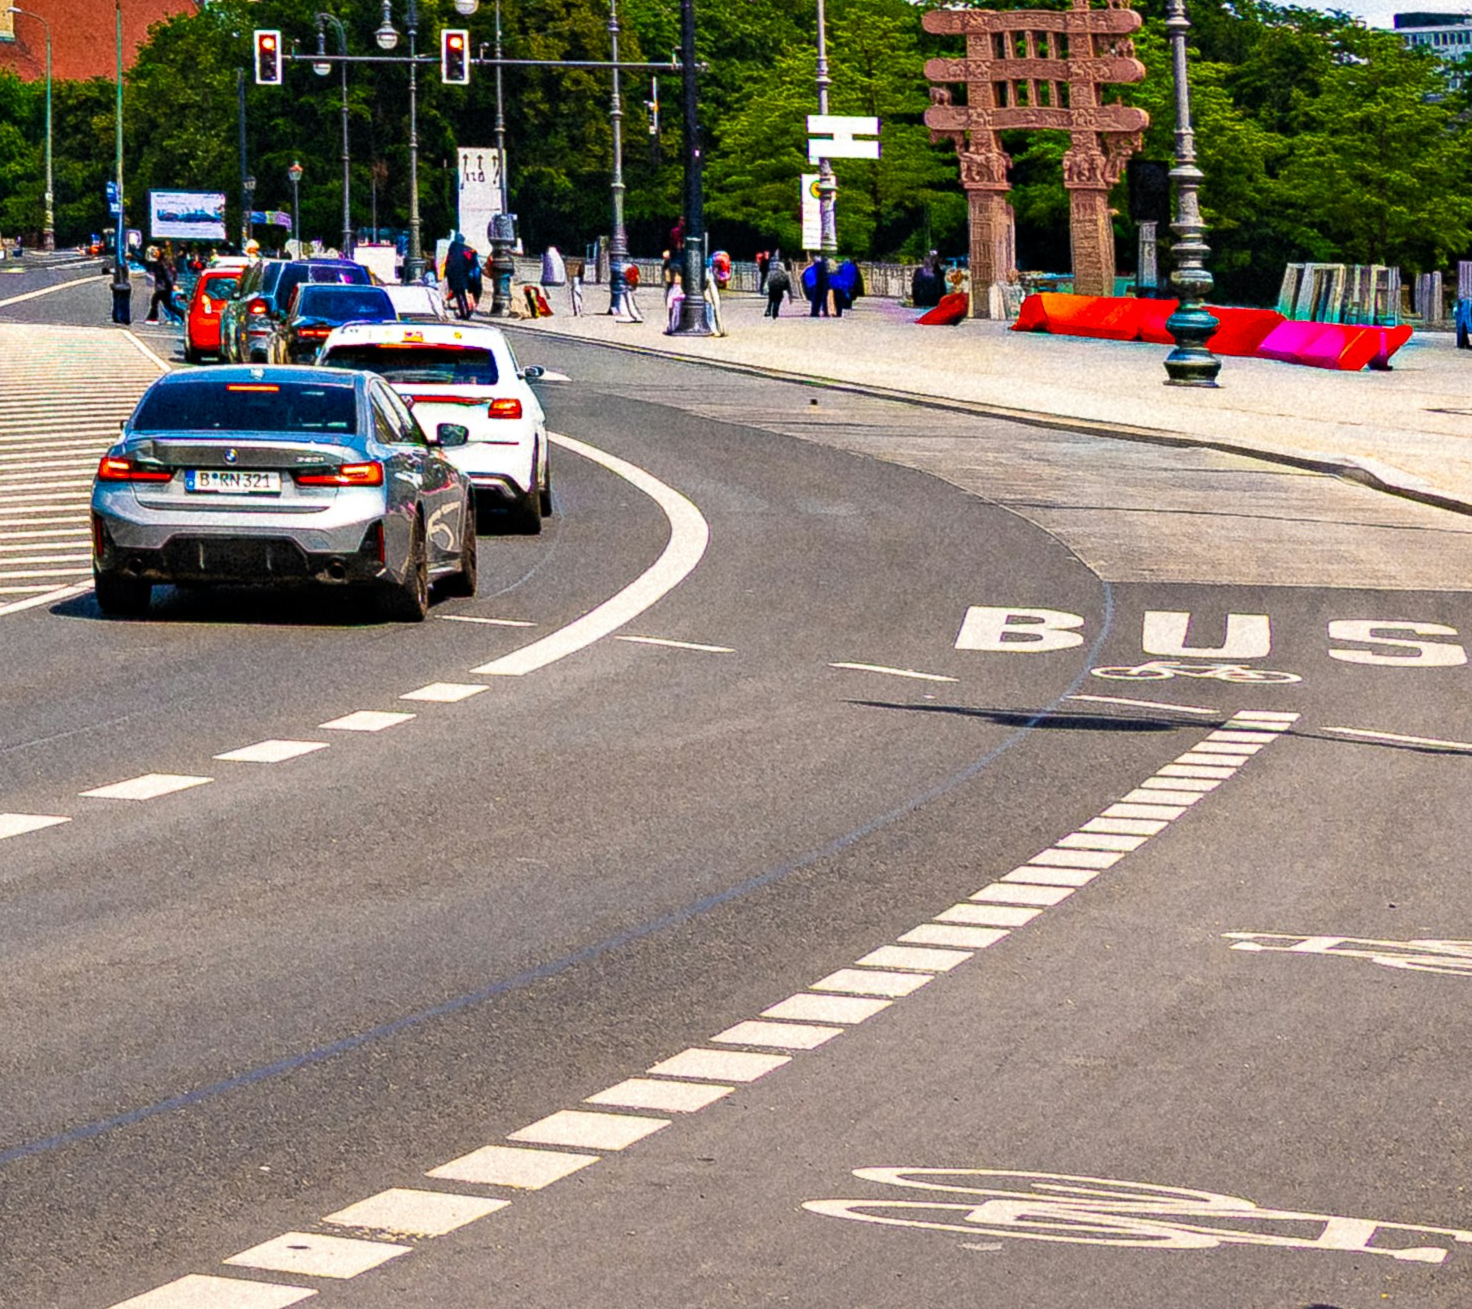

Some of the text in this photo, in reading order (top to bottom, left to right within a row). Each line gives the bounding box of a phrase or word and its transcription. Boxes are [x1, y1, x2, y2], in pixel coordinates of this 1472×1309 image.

[199, 472, 210, 487] B
[243, 474, 271, 488] 321
[954, 605, 1470, 667] BUS
